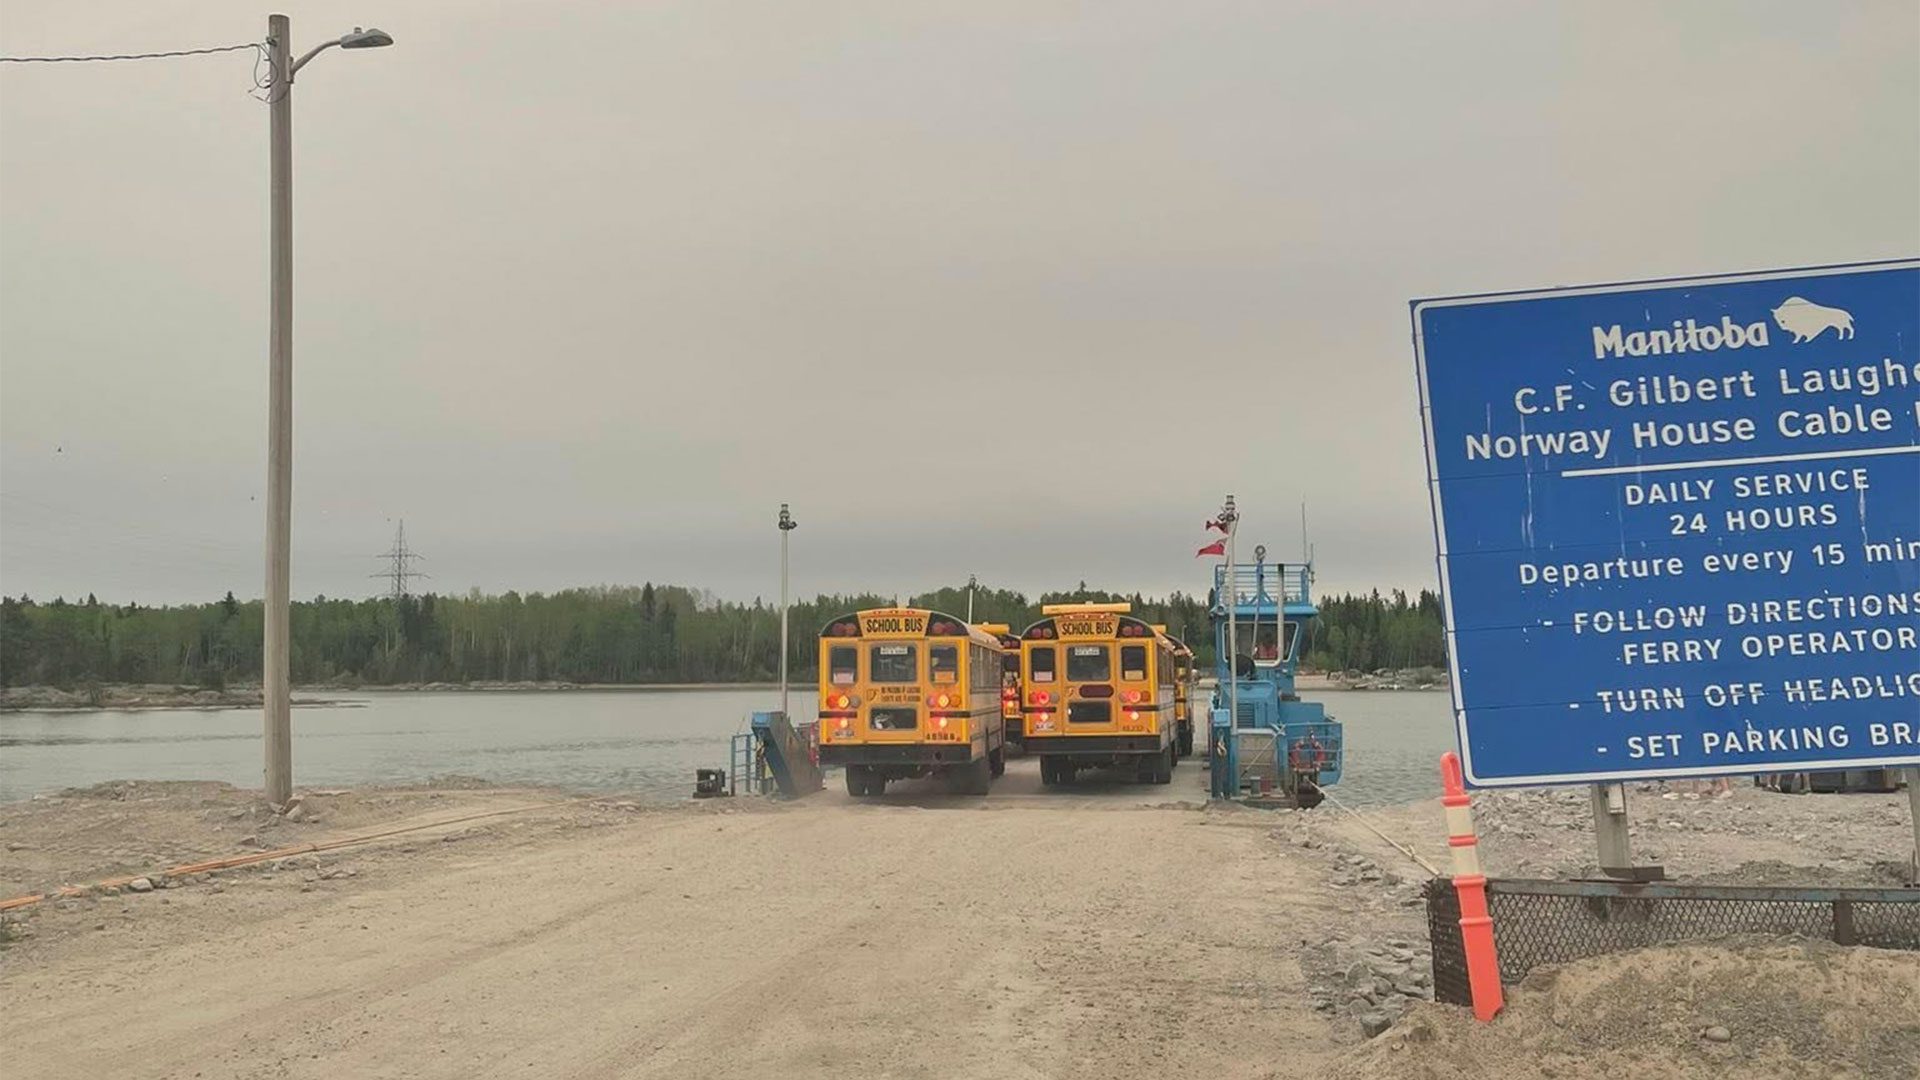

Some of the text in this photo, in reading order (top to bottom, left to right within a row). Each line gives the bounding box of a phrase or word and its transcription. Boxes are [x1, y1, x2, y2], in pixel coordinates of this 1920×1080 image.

[1593, 317, 1769, 359] Manitoba
[1515, 386, 1585, 414] C.F.
[1610, 370, 1756, 407] Gilbert
[1466, 430, 1611, 460] Norway
[1634, 418, 1756, 449] House
[1779, 405, 1893, 438] Cable
[1626, 469, 1869, 506] DAILY SERVICE
[1671, 503, 1837, 535] 24 HOURS
[1520, 556, 1683, 588] Departure
[1704, 545, 1794, 575] every
[1812, 543, 1845, 566] 15
[866, 618, 923, 633] SCHOOL BUS
[1062, 622, 1113, 635] SCHOOL BUS
[1574, 605, 1706, 634] FOLLOW
[1624, 627, 1917, 664] FERRY OPERATOR
[1596, 686, 1684, 713] TURN
[1704, 682, 1765, 707] OFF
[1627, 734, 1682, 759] SET
[1703, 722, 1850, 754] PARKING
[1869, 722, 1920, 745] BR
